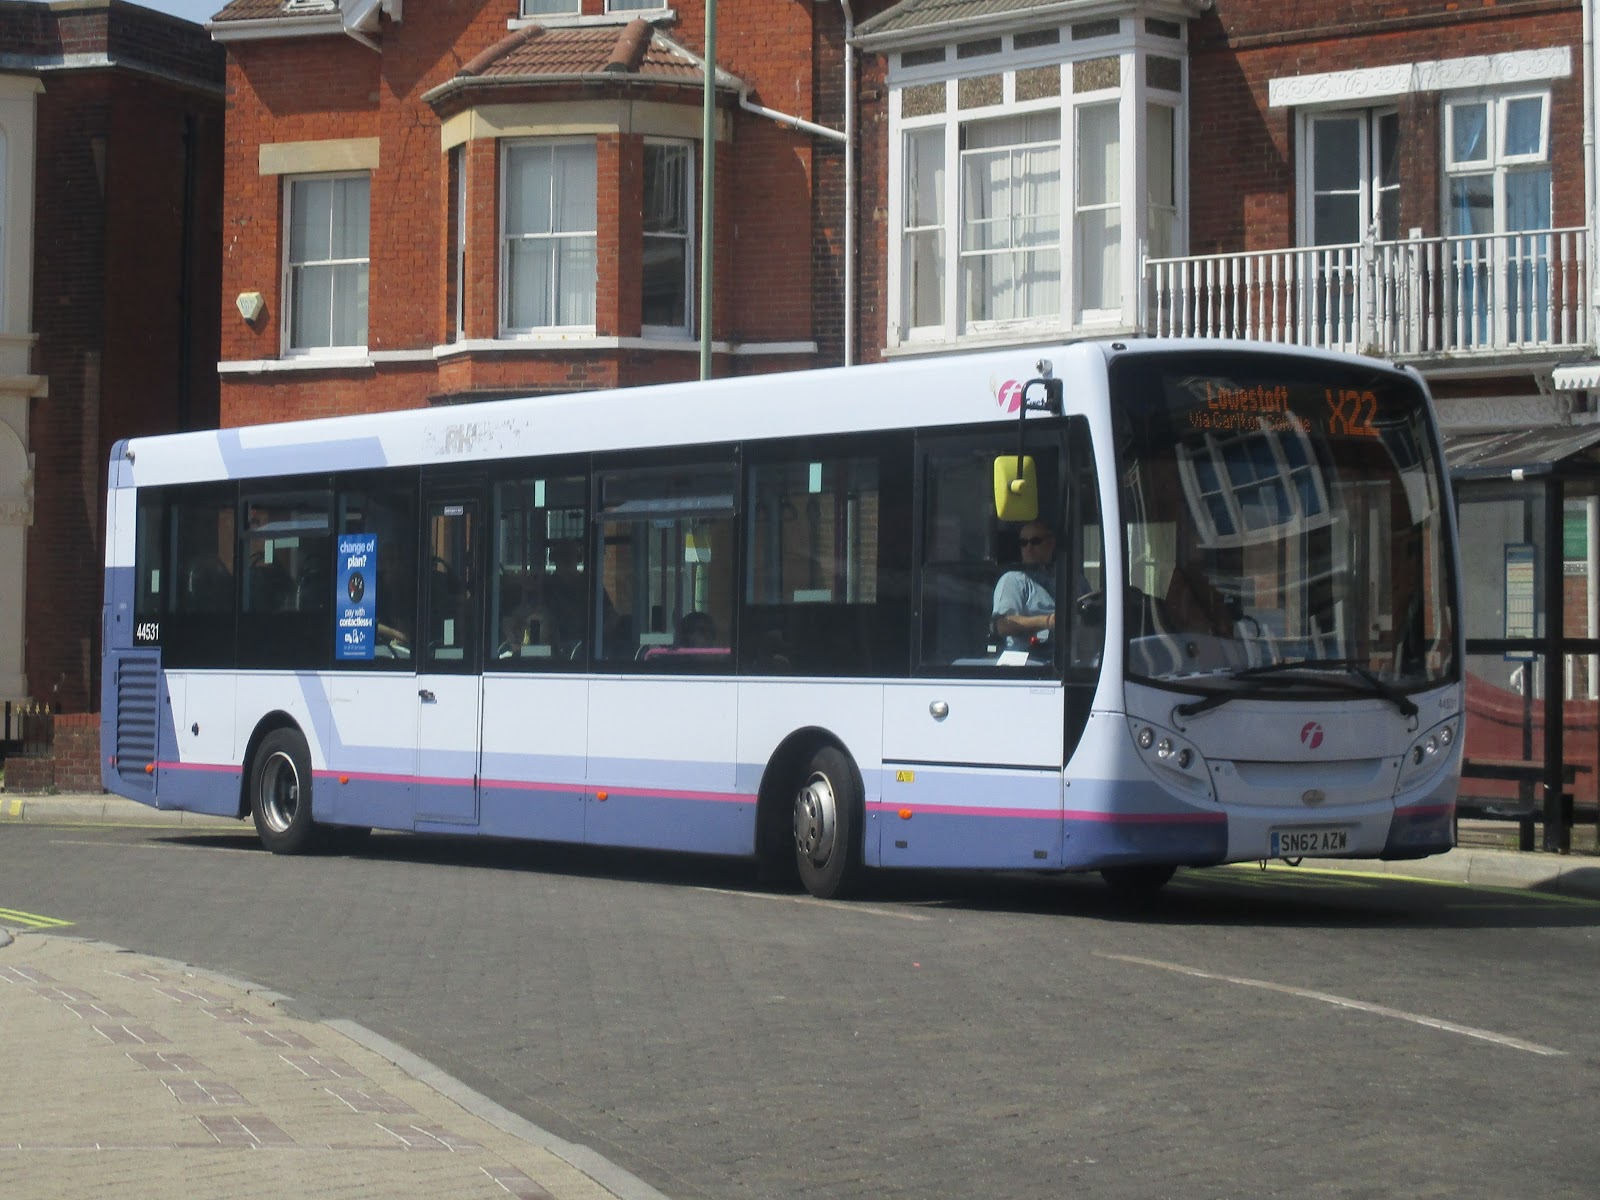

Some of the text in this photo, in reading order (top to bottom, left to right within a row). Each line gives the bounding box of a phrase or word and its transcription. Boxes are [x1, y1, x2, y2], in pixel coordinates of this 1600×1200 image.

[1206, 381, 1289, 412] Lowestoft
[1325, 388, 1381, 437] X22
[340, 539, 375, 554] change of
[347, 554, 367, 570] plan?
[344, 606, 366, 618] pay with
[339, 616, 369, 628] contactless
[136, 622, 160, 641] 44531
[1281, 831, 1347, 852] SN62 AZW
